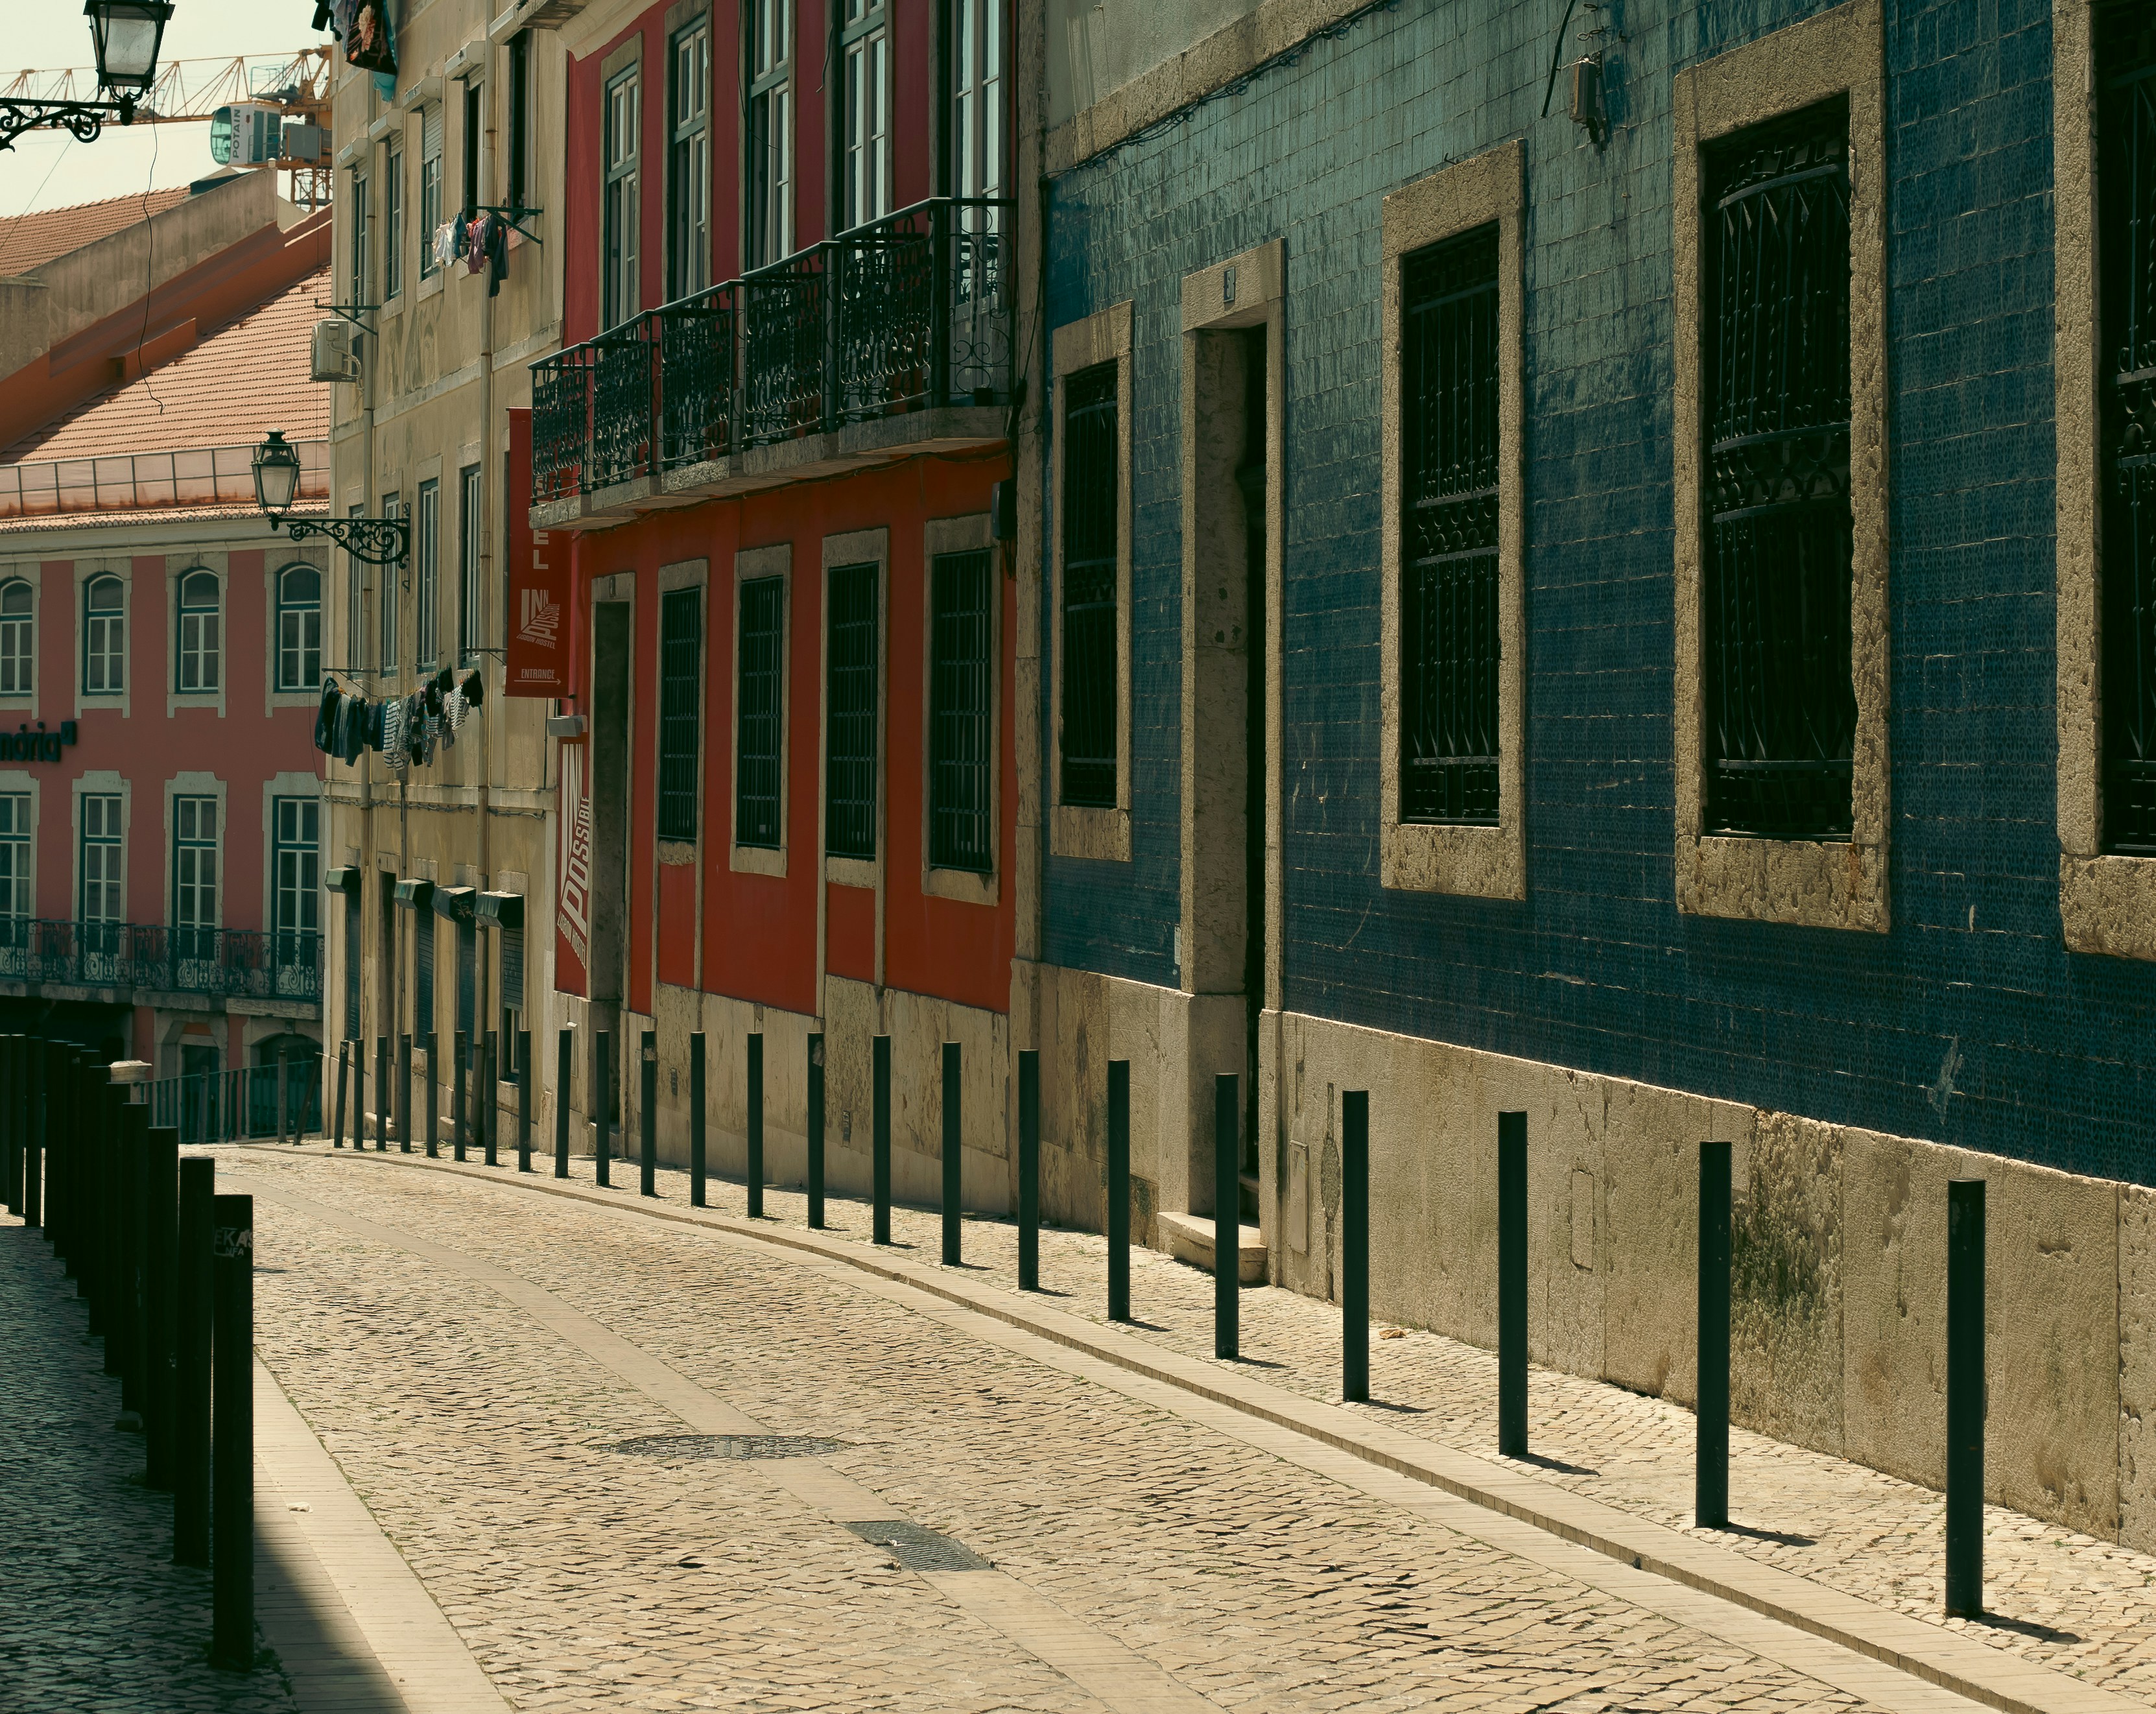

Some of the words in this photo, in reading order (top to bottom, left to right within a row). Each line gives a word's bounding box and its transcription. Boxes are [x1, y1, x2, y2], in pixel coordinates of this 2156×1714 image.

[521, 588, 549, 631] INN
[536, 638, 556, 649] HOSTEL
[521, 668, 556, 680] ENTRANCE
[561, 743, 582, 900] INN
